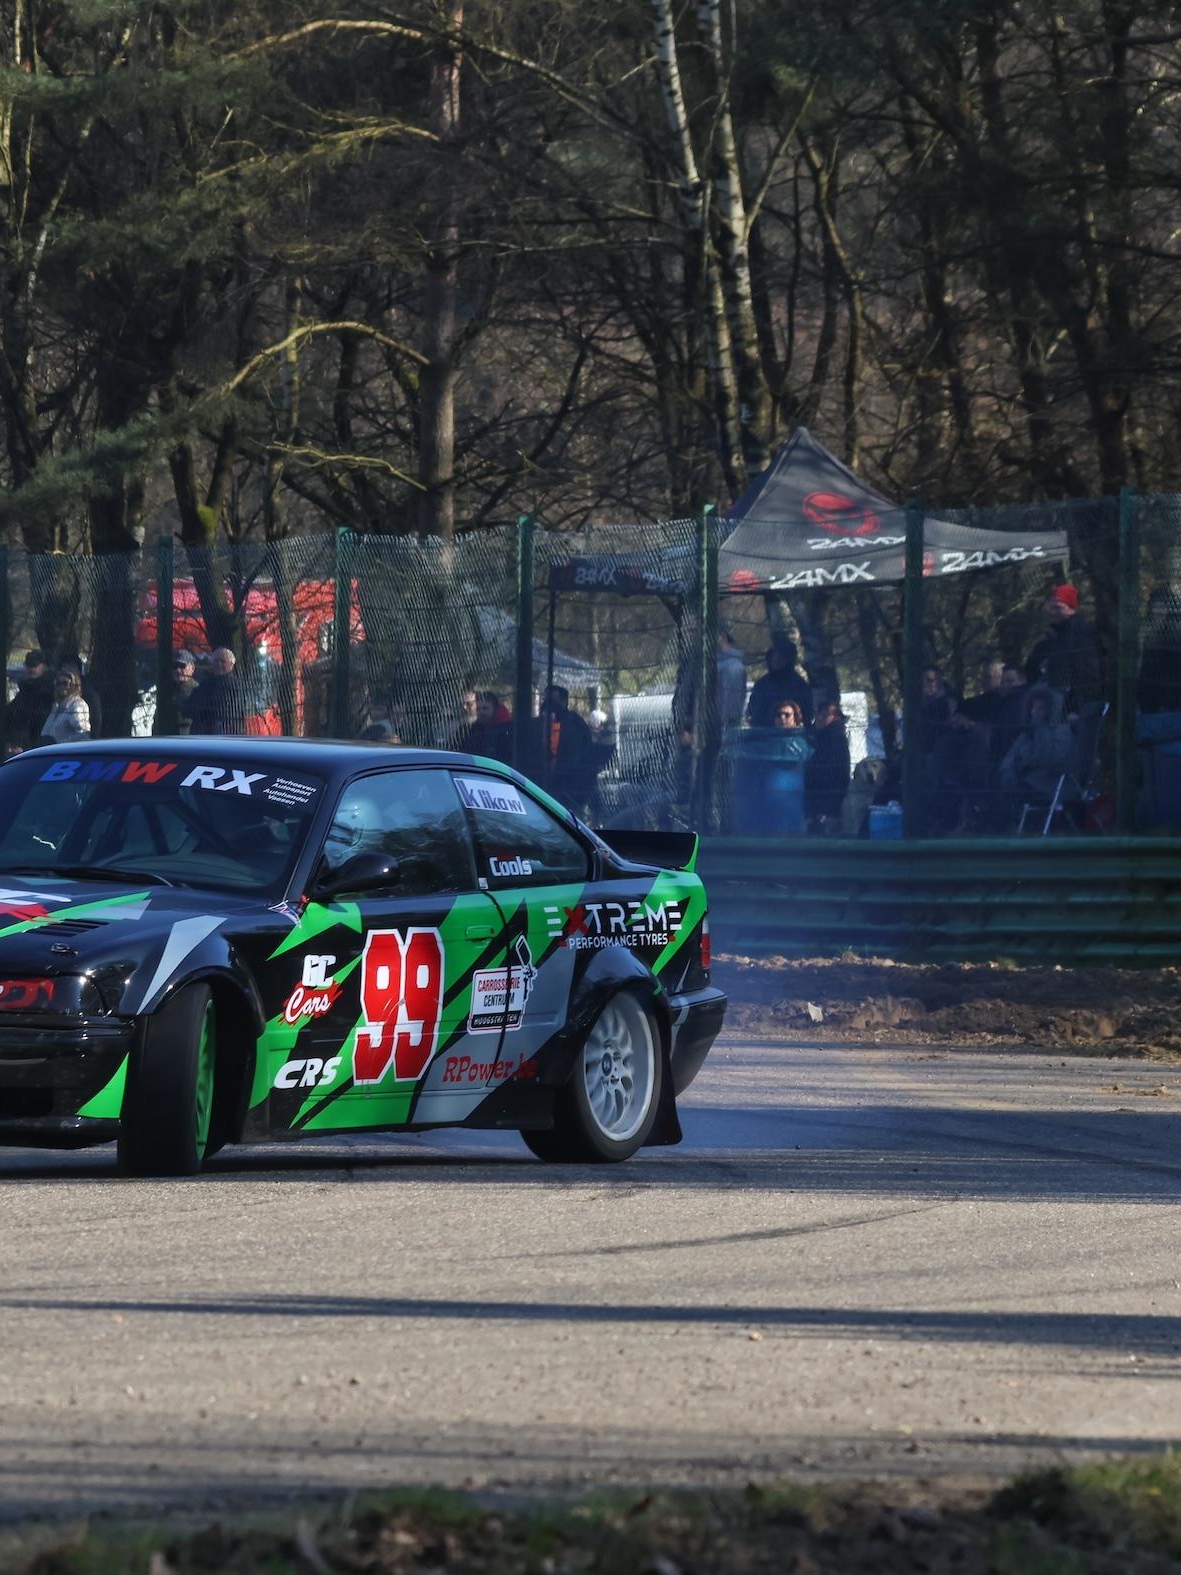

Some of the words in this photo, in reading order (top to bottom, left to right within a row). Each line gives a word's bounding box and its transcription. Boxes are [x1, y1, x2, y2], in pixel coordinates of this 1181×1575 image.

[38, 760, 179, 784] BMW
[179, 765, 268, 796] RX
[272, 782, 312, 797] Autosport
[276, 777, 317, 793] Verhoeven
[262, 788, 310, 804] Autohandel
[489, 855, 533, 877] Cools
[543, 901, 683, 938] EXTREME
[569, 934, 638, 950] PERFORMANCE
[639, 932, 669, 946] TYRES
[285, 986, 332, 1023] Cars
[353, 927, 445, 1086] 99
[273, 1056, 343, 1089] CRS
